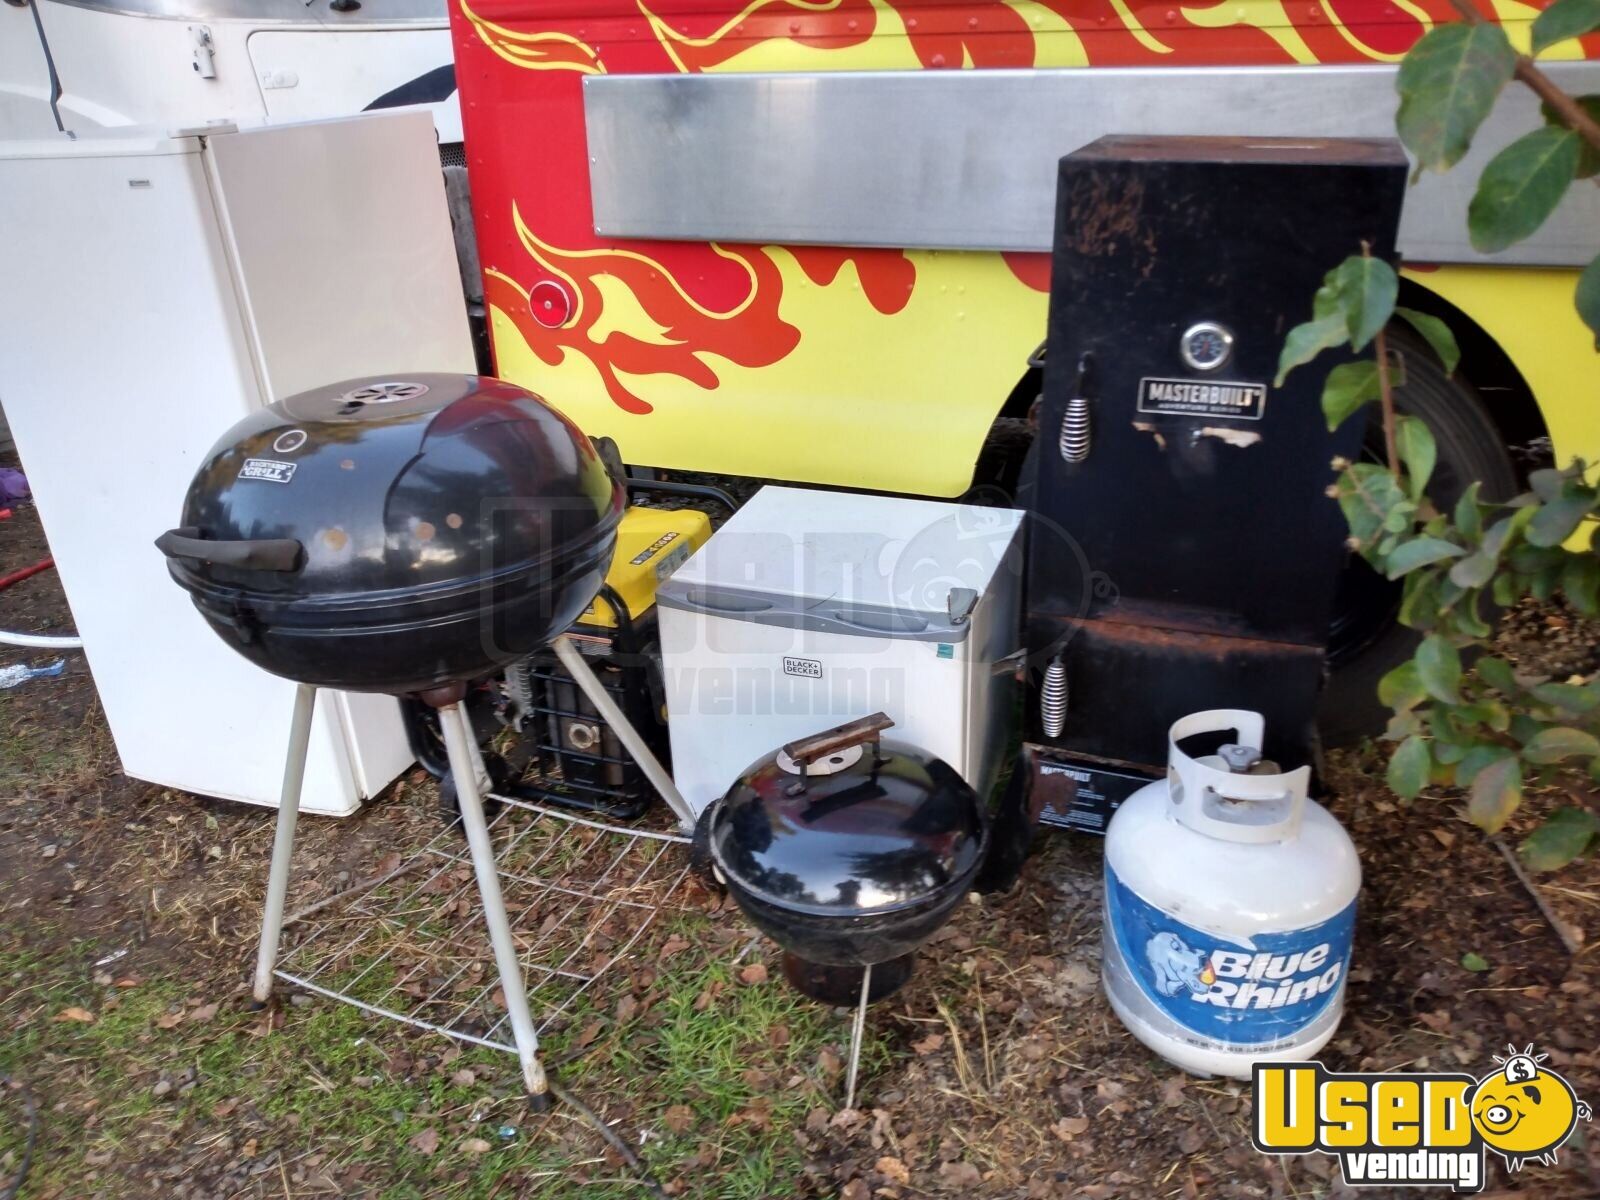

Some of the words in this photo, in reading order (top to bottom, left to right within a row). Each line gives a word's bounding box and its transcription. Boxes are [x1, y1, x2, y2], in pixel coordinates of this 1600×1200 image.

[1149, 383, 1253, 406] MASTERBUILT
[244, 467, 282, 479] GRILL
[786, 659, 818, 669] BLACK+
[786, 665, 819, 676] DECKER
[1211, 943, 1331, 980] Blue
[1191, 961, 1341, 1010] Rhino
